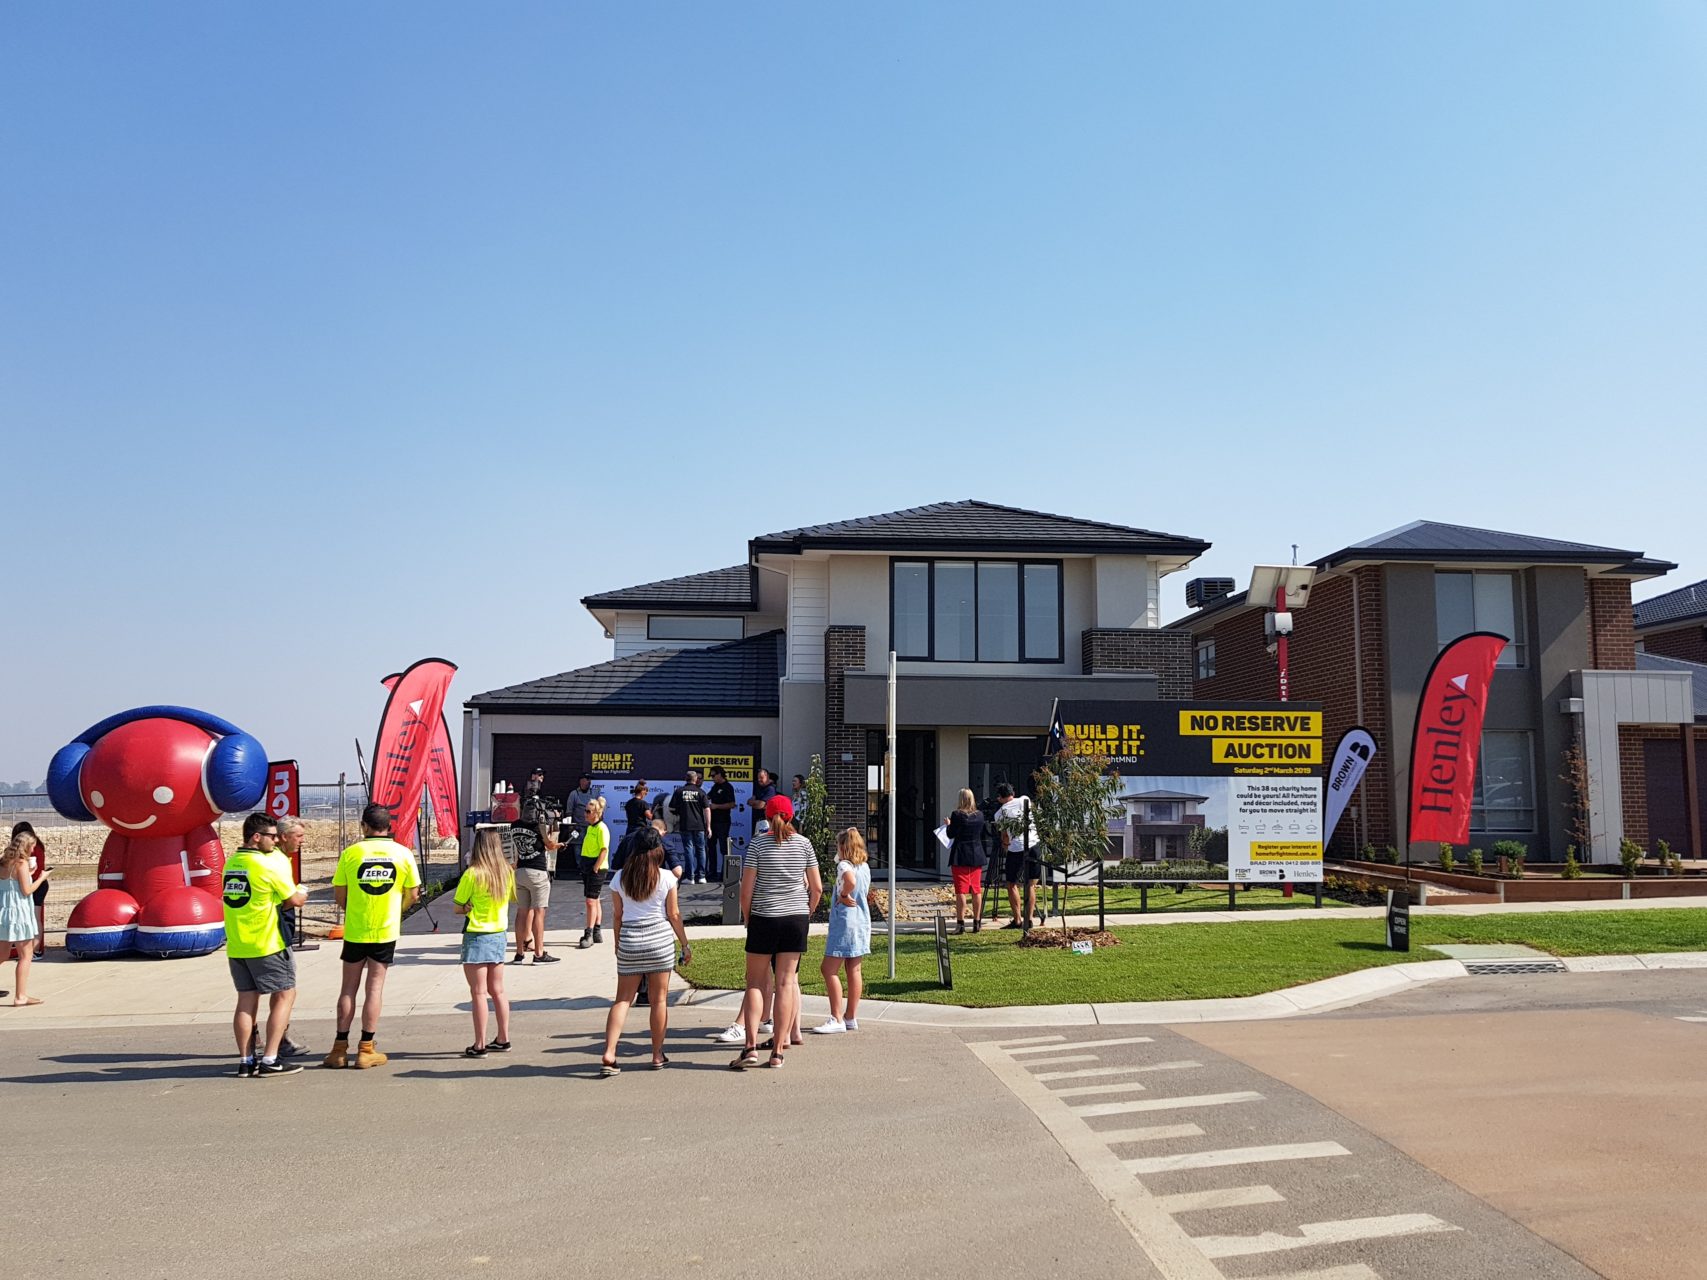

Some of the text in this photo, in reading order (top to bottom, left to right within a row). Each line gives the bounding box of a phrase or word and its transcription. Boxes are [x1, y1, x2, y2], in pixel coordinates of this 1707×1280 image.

[1190, 715, 1311, 732] NO RESERVE
[1063, 724, 1145, 739] BUILD IT.
[1066, 740, 1145, 755] IGHT IT.
[1223, 742, 1311, 759] AUCTION
[1419, 682, 1477, 814] Henley
[591, 753, 621, 762] BUILD
[693, 757, 749, 766] NO RESERVE
[591, 761, 621, 770] FIGHT
[708, 770, 749, 779] TION
[1234, 767, 1264, 775] Saturday
[1331, 755, 1355, 791] BROWN
[1278, 785, 1300, 793] charity
[1293, 870, 1314, 878] Henley
[226, 882, 244, 890] ZERO
